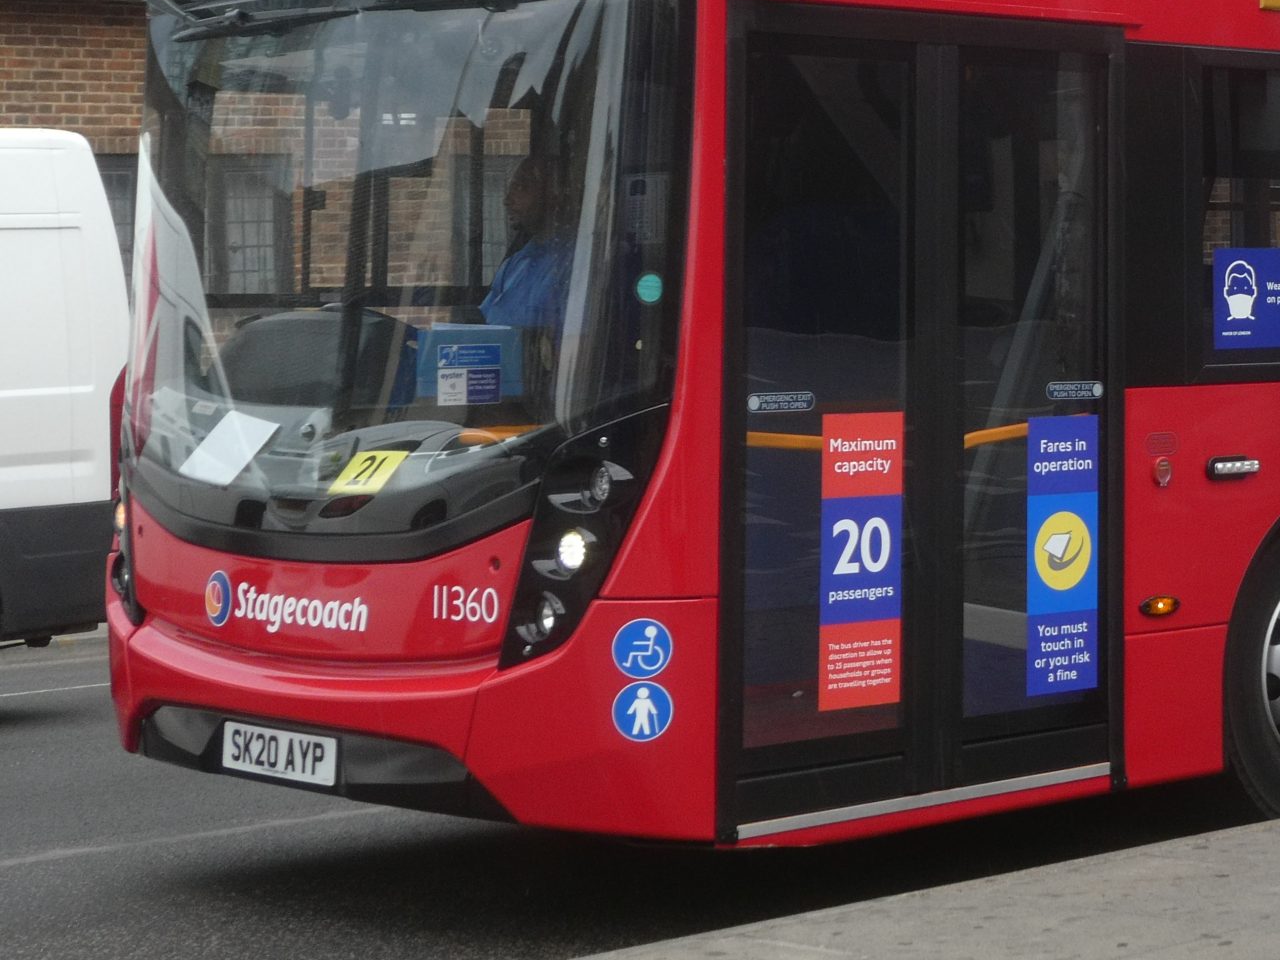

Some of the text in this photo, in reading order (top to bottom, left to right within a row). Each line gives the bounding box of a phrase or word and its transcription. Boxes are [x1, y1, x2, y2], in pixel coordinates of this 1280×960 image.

[829, 438, 897, 453] Maximum
[1040, 438, 1086, 453] Fares in
[345, 454, 389, 486] 21
[834, 457, 892, 475] capacity
[1033, 457, 1093, 475] operation
[832, 517, 891, 575] 20
[433, 584, 499, 623] 11360
[828, 586, 894, 604] passengers
[235, 582, 368, 633] Stagecoach
[1037, 621, 1088, 637] You must
[828, 643, 840, 651] The
[840, 642, 852, 650] bus
[1041, 637, 1084, 652] touch in
[1034, 651, 1090, 670] or you risk
[1047, 669, 1077, 682] a fine
[231, 729, 325, 776] SK20 AYP
